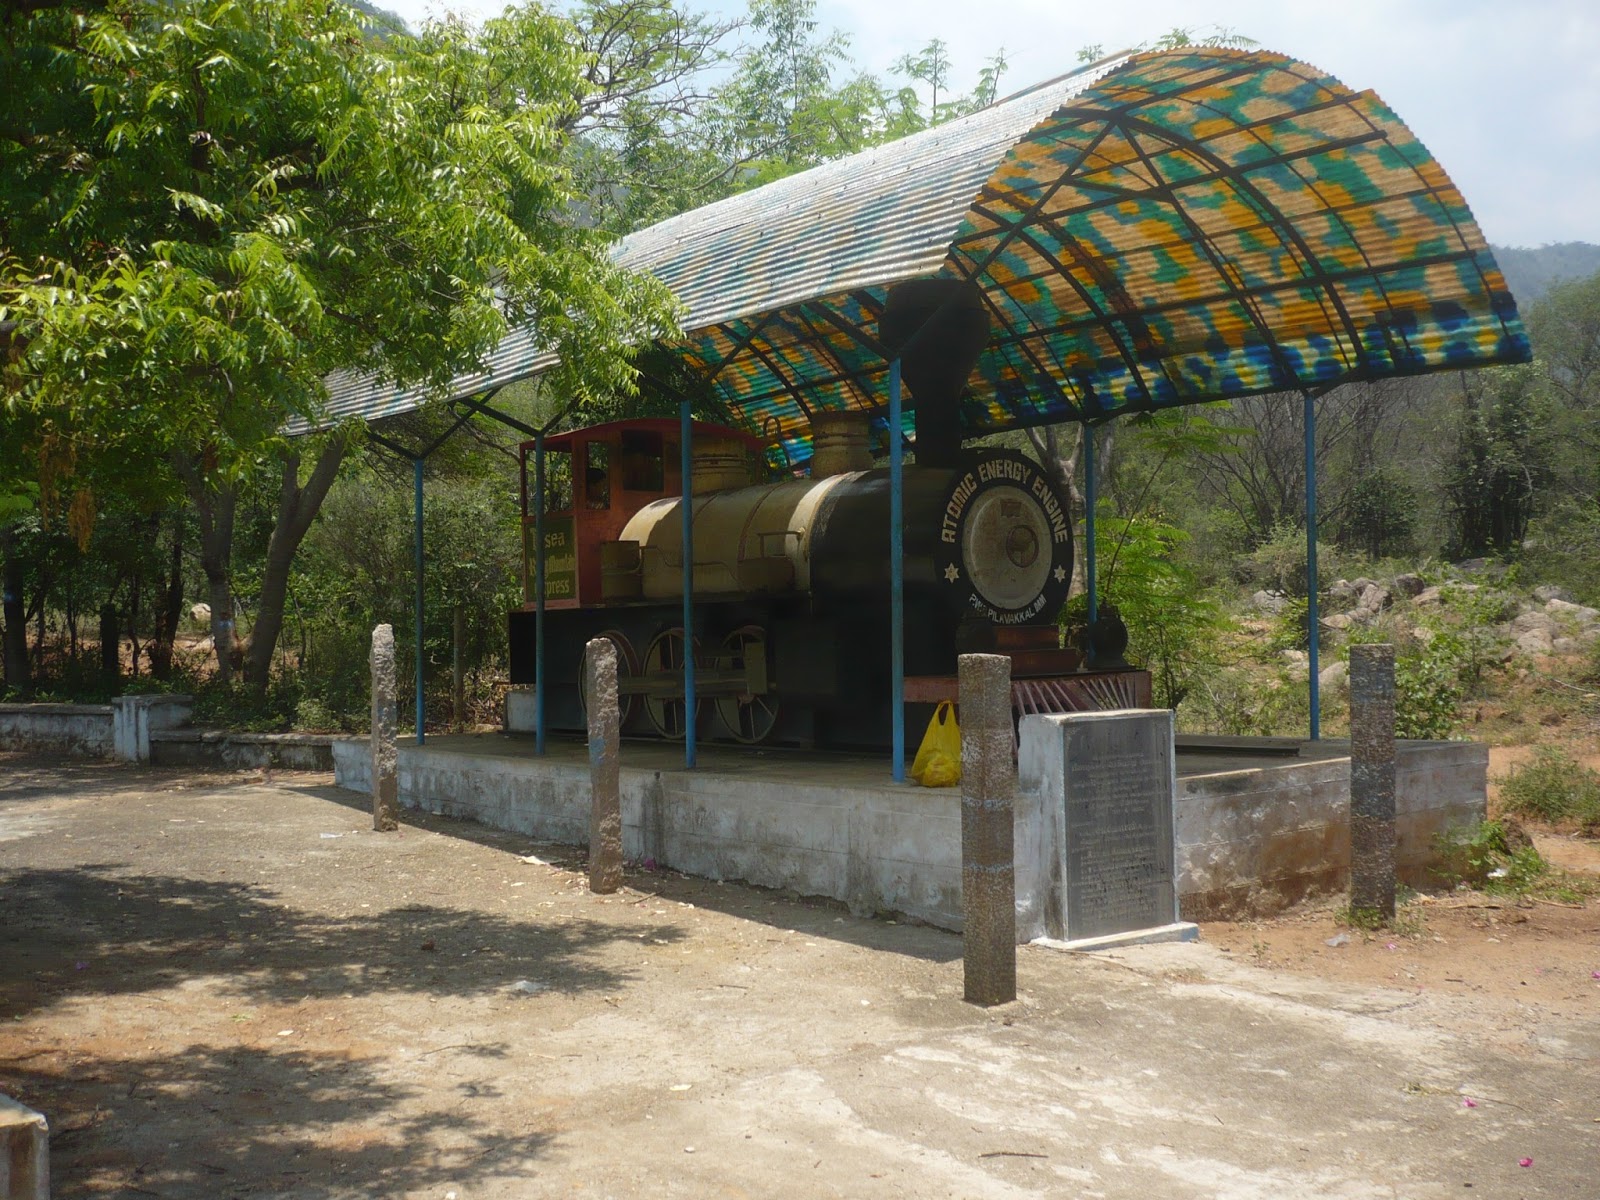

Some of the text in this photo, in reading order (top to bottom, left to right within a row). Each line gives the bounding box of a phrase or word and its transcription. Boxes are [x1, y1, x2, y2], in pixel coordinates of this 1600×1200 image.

[941, 459, 1068, 543] ATOMIC ENERGY ENGINE
